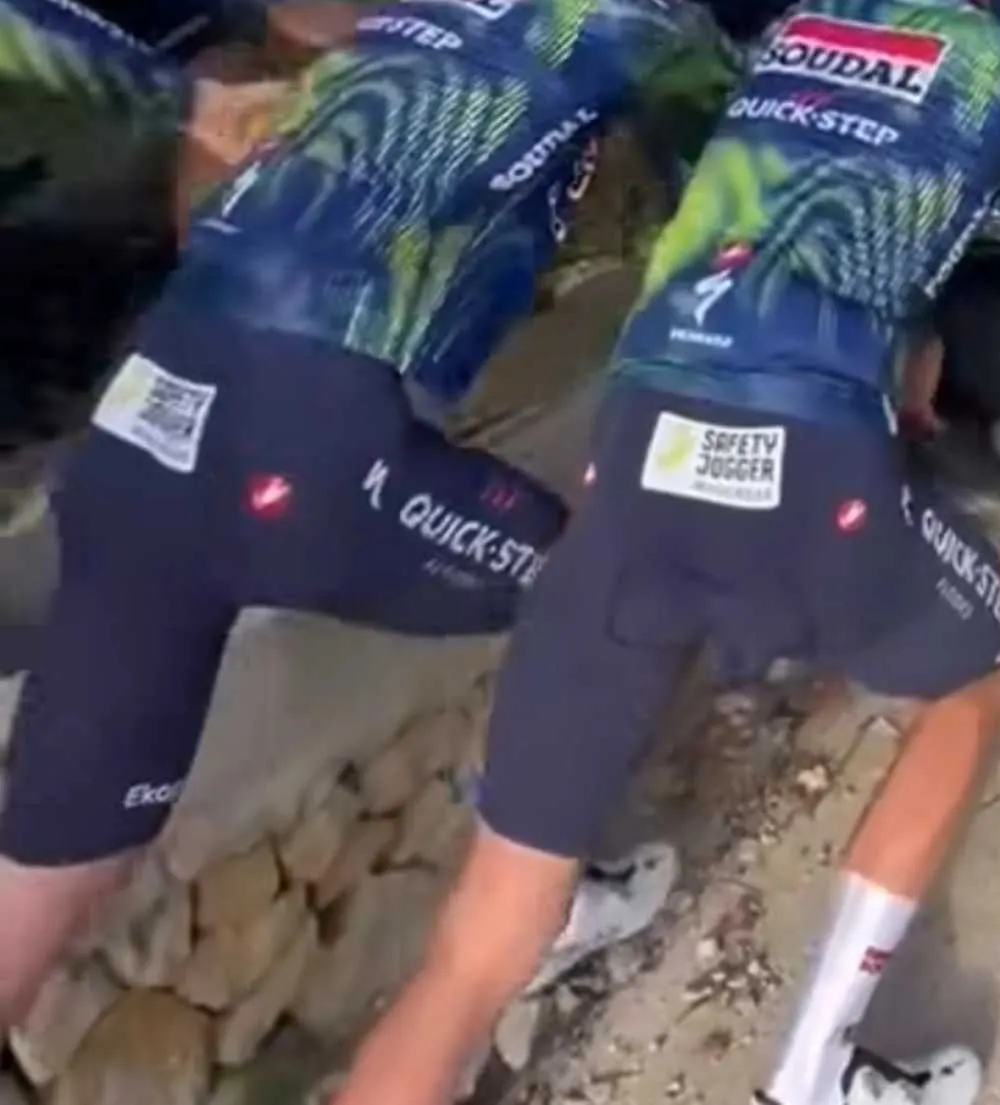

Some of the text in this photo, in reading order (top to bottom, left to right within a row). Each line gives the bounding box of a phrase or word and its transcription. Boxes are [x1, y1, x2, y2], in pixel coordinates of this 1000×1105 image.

[762, 44, 922, 93] SOUDAL
[701, 429, 778, 456] SAFETY
[695, 453, 775, 482] JOGGER
[124, 782, 173, 808] Eko
